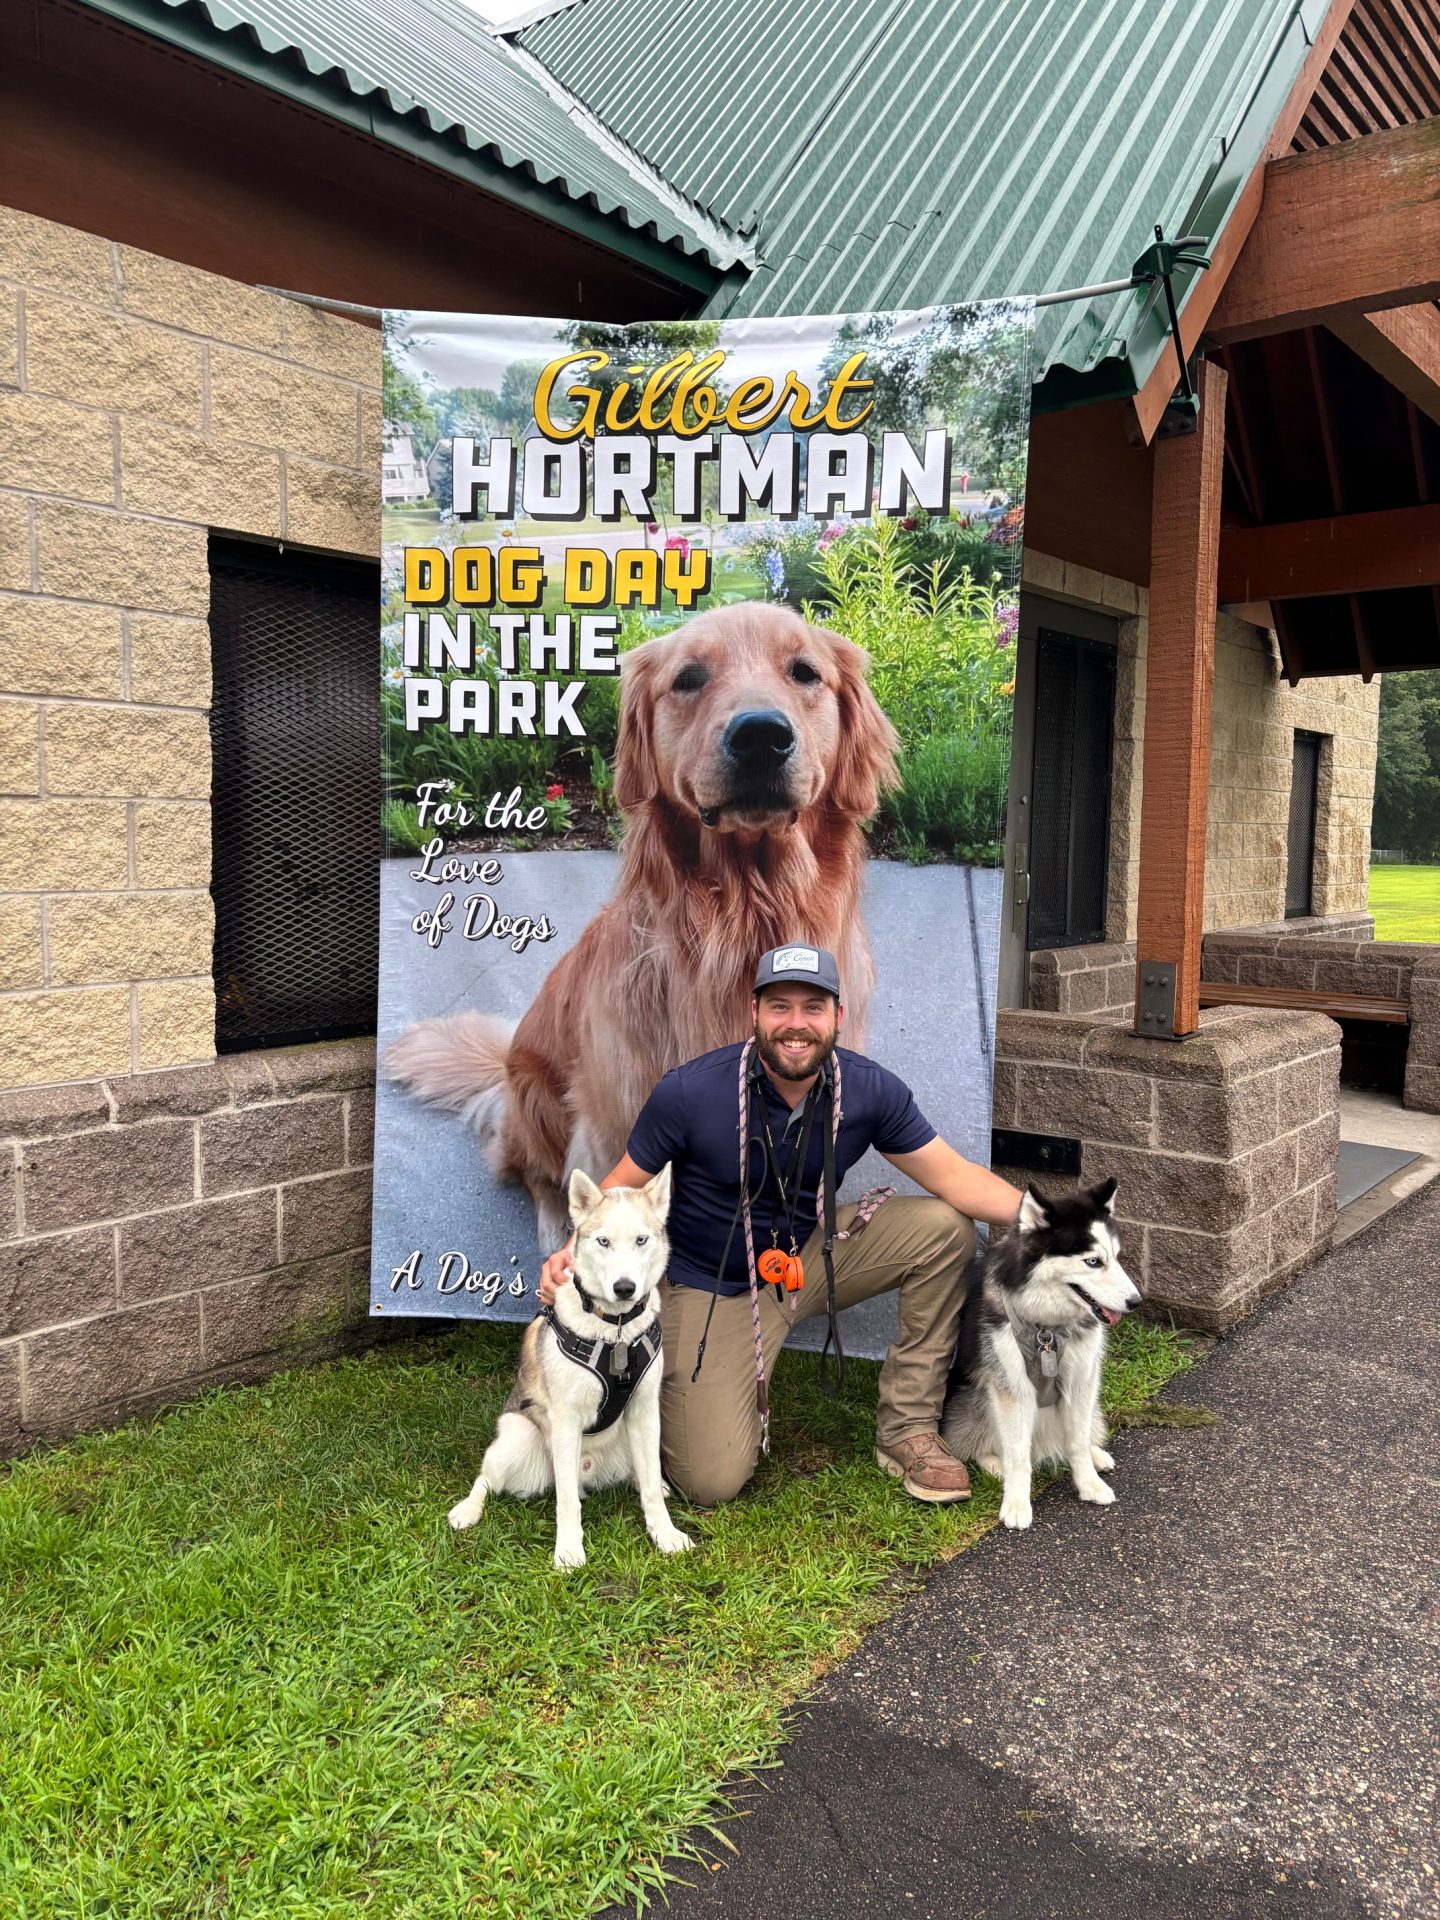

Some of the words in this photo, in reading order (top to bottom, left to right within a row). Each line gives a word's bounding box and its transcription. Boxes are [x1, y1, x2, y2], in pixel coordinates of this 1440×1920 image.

[533, 349, 875, 443] Gilbert
[451, 428, 950, 522] HORTMAN
[404, 546, 547, 607] DOG
[563, 547, 712, 610] DAY
[403, 611, 475, 673] IN
[488, 613, 621, 676] THE
[403, 676, 590, 739] PARK
[415, 782, 475, 828] For
[484, 785, 548, 831] the
[409, 837, 504, 884] Love
[411, 892, 454, 948] of
[462, 893, 558, 953] Dogs
[389, 1249, 424, 1293] A
[436, 1250, 529, 1307] Dog's
